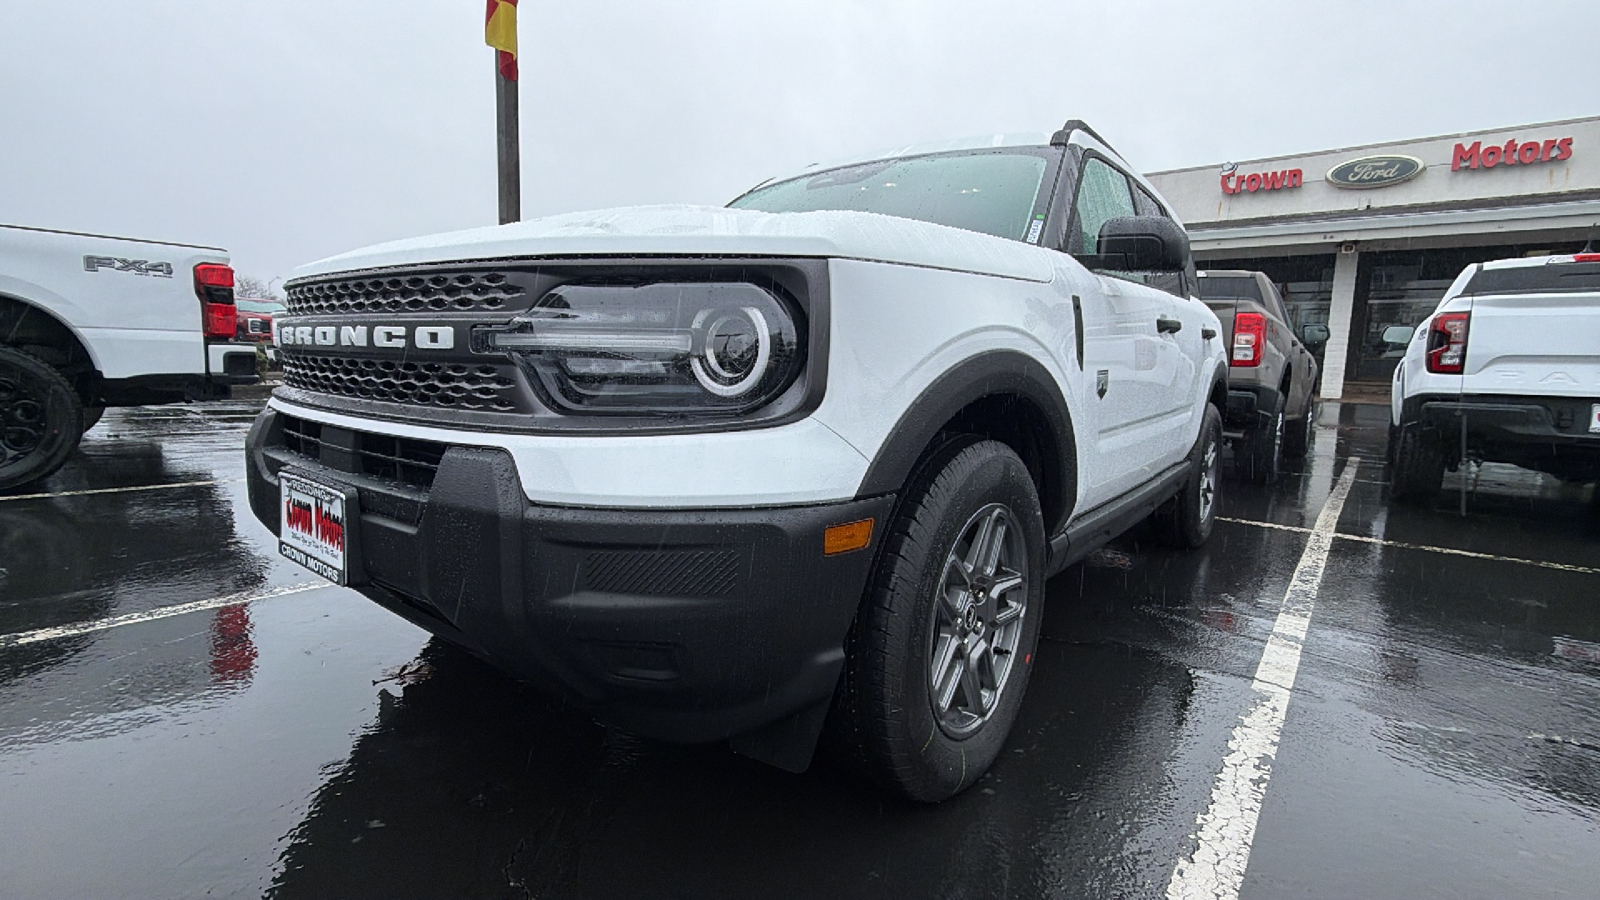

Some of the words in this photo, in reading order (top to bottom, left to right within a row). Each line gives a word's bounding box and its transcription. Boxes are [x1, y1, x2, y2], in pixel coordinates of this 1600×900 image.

[1220, 166, 1303, 195] Crown
[1347, 160, 1399, 183] Ford
[1451, 136, 1573, 172] Motors
[83, 255, 173, 276] FX4
[281, 325, 454, 349] BRONCO
[292, 480, 326, 499] REDDING
[281, 544, 306, 566] CROWN
[306, 556, 339, 582] MOTORS
